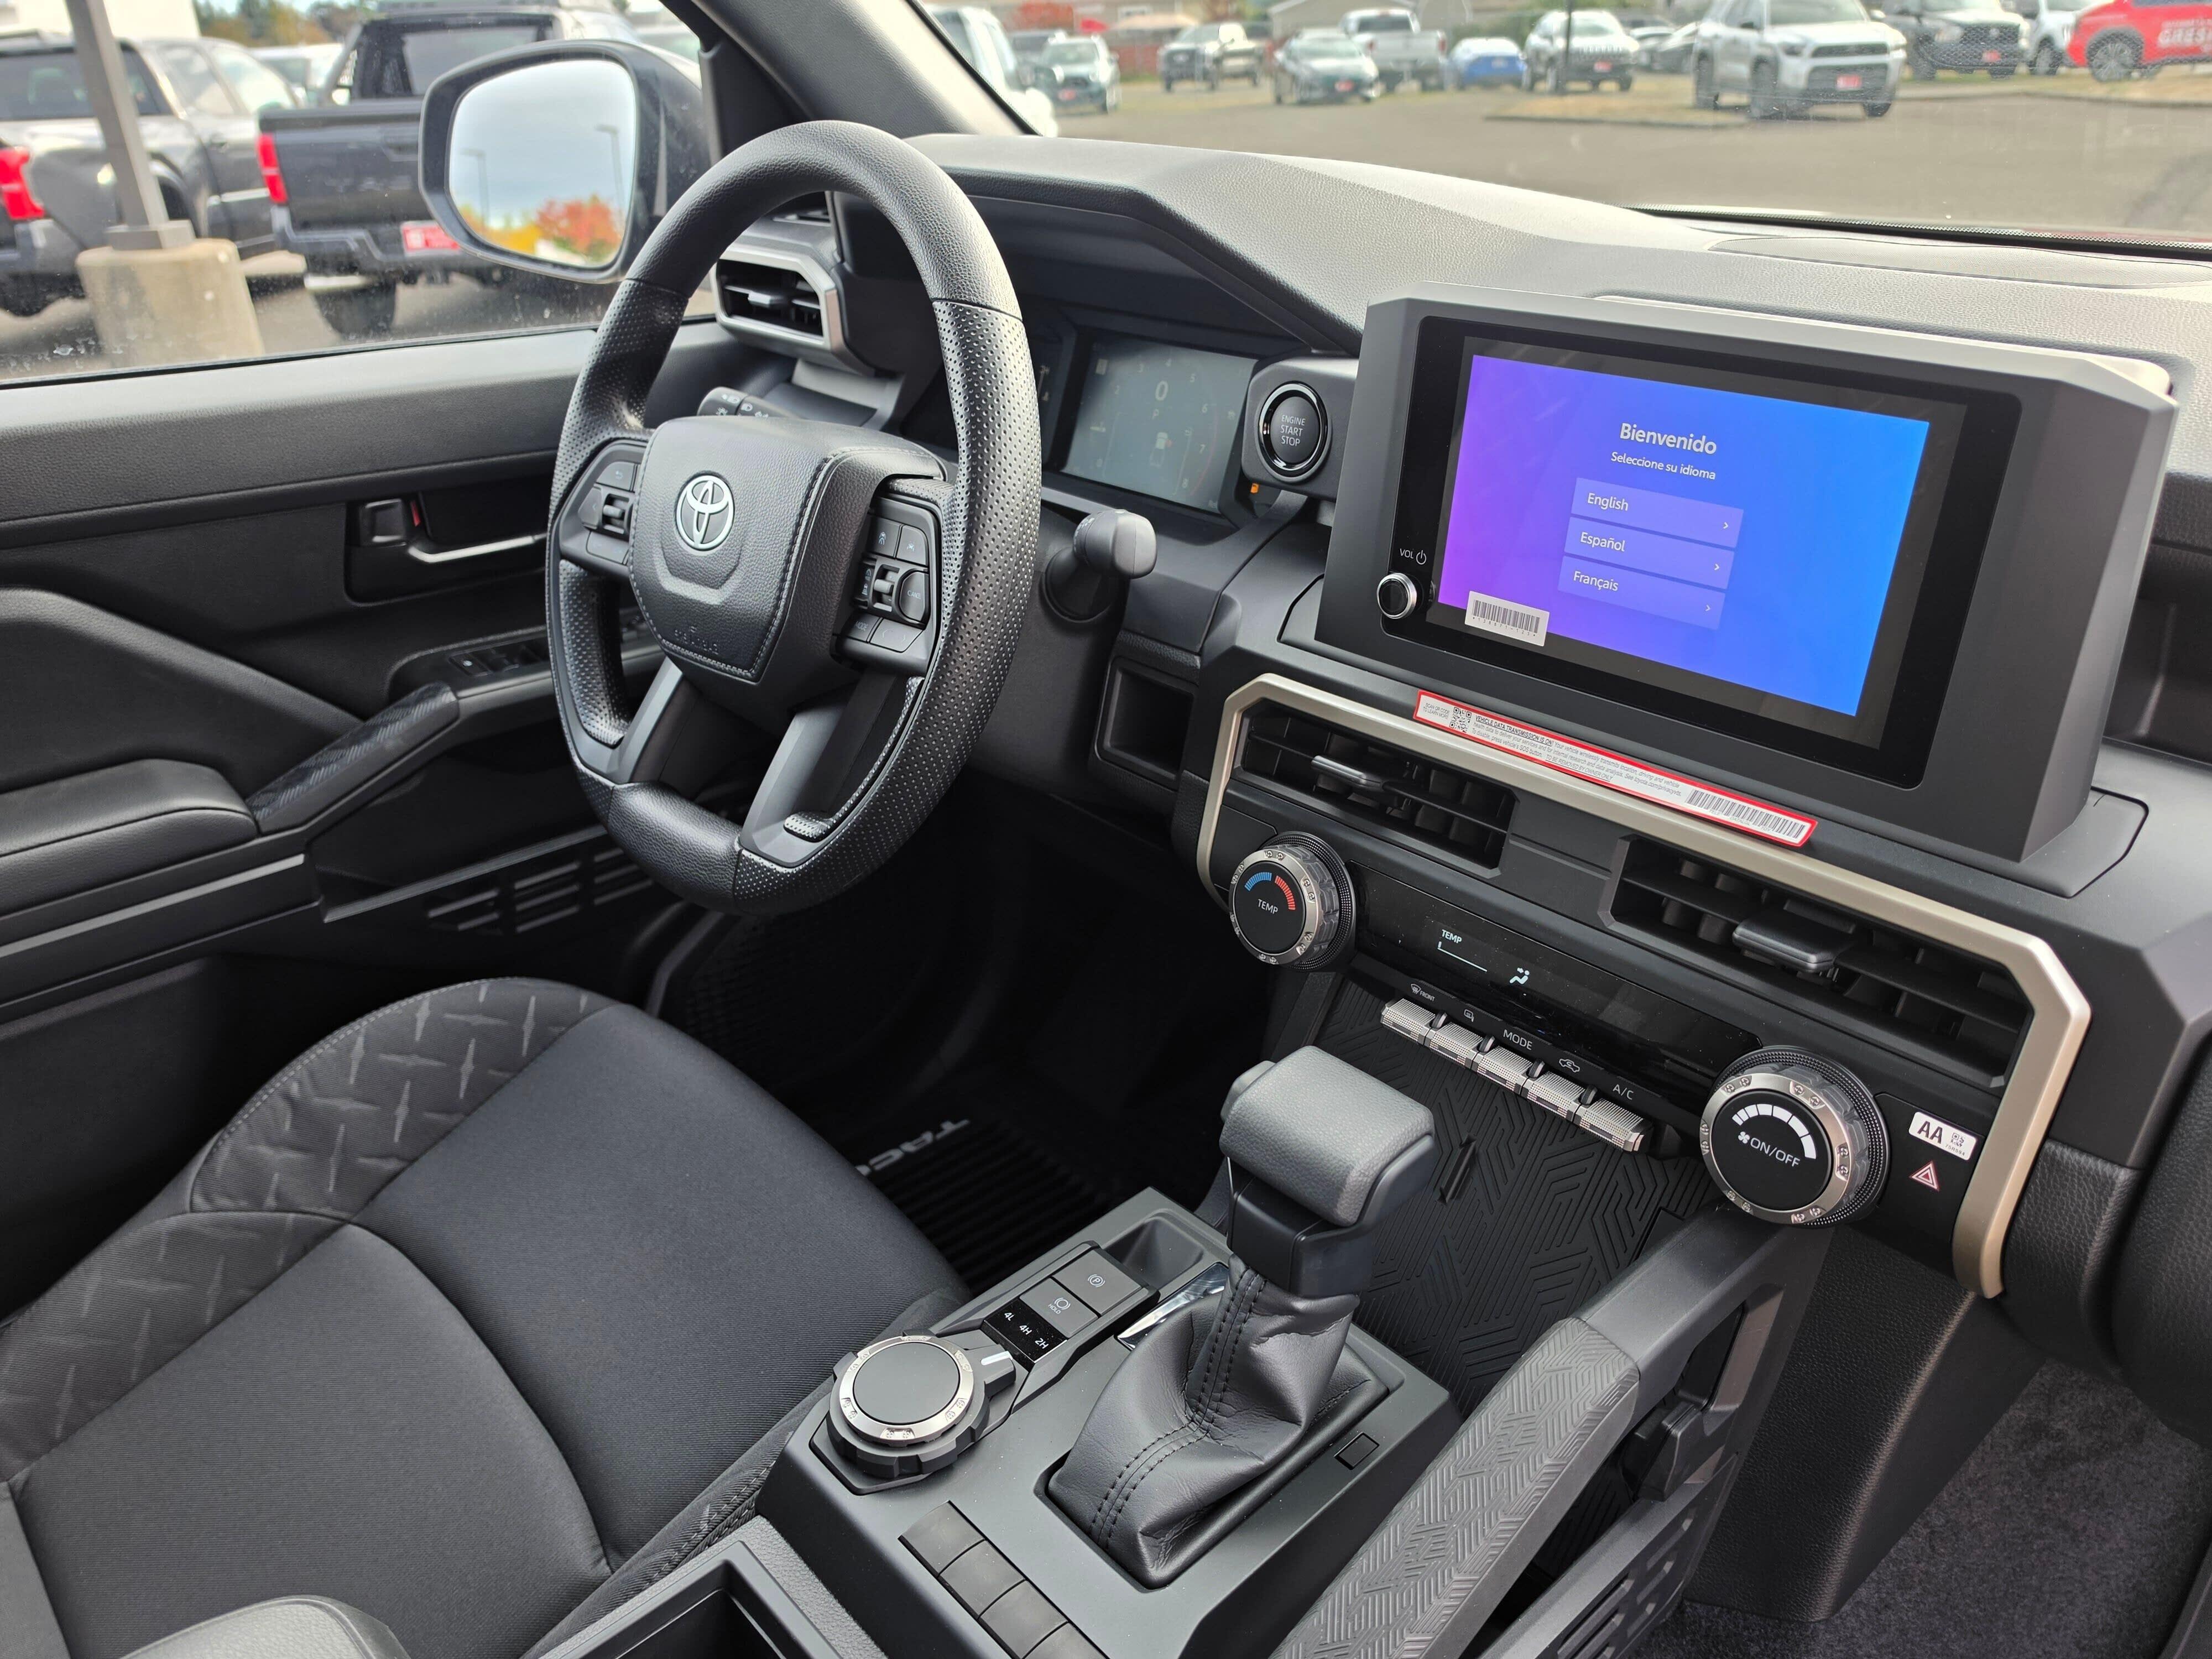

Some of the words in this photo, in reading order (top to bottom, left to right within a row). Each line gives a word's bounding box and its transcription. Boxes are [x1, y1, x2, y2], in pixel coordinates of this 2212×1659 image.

[1155, 380, 1168, 401] 0
[1281, 414, 1306, 426] ENGINE
[1280, 424, 1303, 437] START
[1281, 435, 1300, 446] STOP
[1620, 422, 1717, 455] Bienvenido
[1610, 451, 1664, 470] Seleccione
[1665, 463, 1677, 473] su
[1679, 463, 1716, 480] idioma
[1587, 492, 1629, 511] English
[1580, 531, 1626, 552] Español
[1400, 548, 1414, 559] VOL
[1573, 570, 1619, 591] Français
[1475, 714, 1494, 726] VEHICLE
[1494, 721, 1506, 729] DATA
[1506, 725, 1540, 740] TRANSMISSION
[1258, 899, 1279, 914] TEMP
[1442, 929, 1462, 943] TEMP
[1420, 990, 1435, 1001] FRONT
[1503, 1029, 1532, 1050] MODE
[1613, 1084, 1634, 1100] A/C
[1917, 1121, 1943, 1144] AA
[1750, 1138, 1801, 1167] ON/OFF
[1004, 1312, 1015, 1321] 4L
[1048, 1304, 1061, 1314] HOLD
[1019, 1325, 1032, 1335] 4H
[1035, 1338, 1049, 1349] 2H
